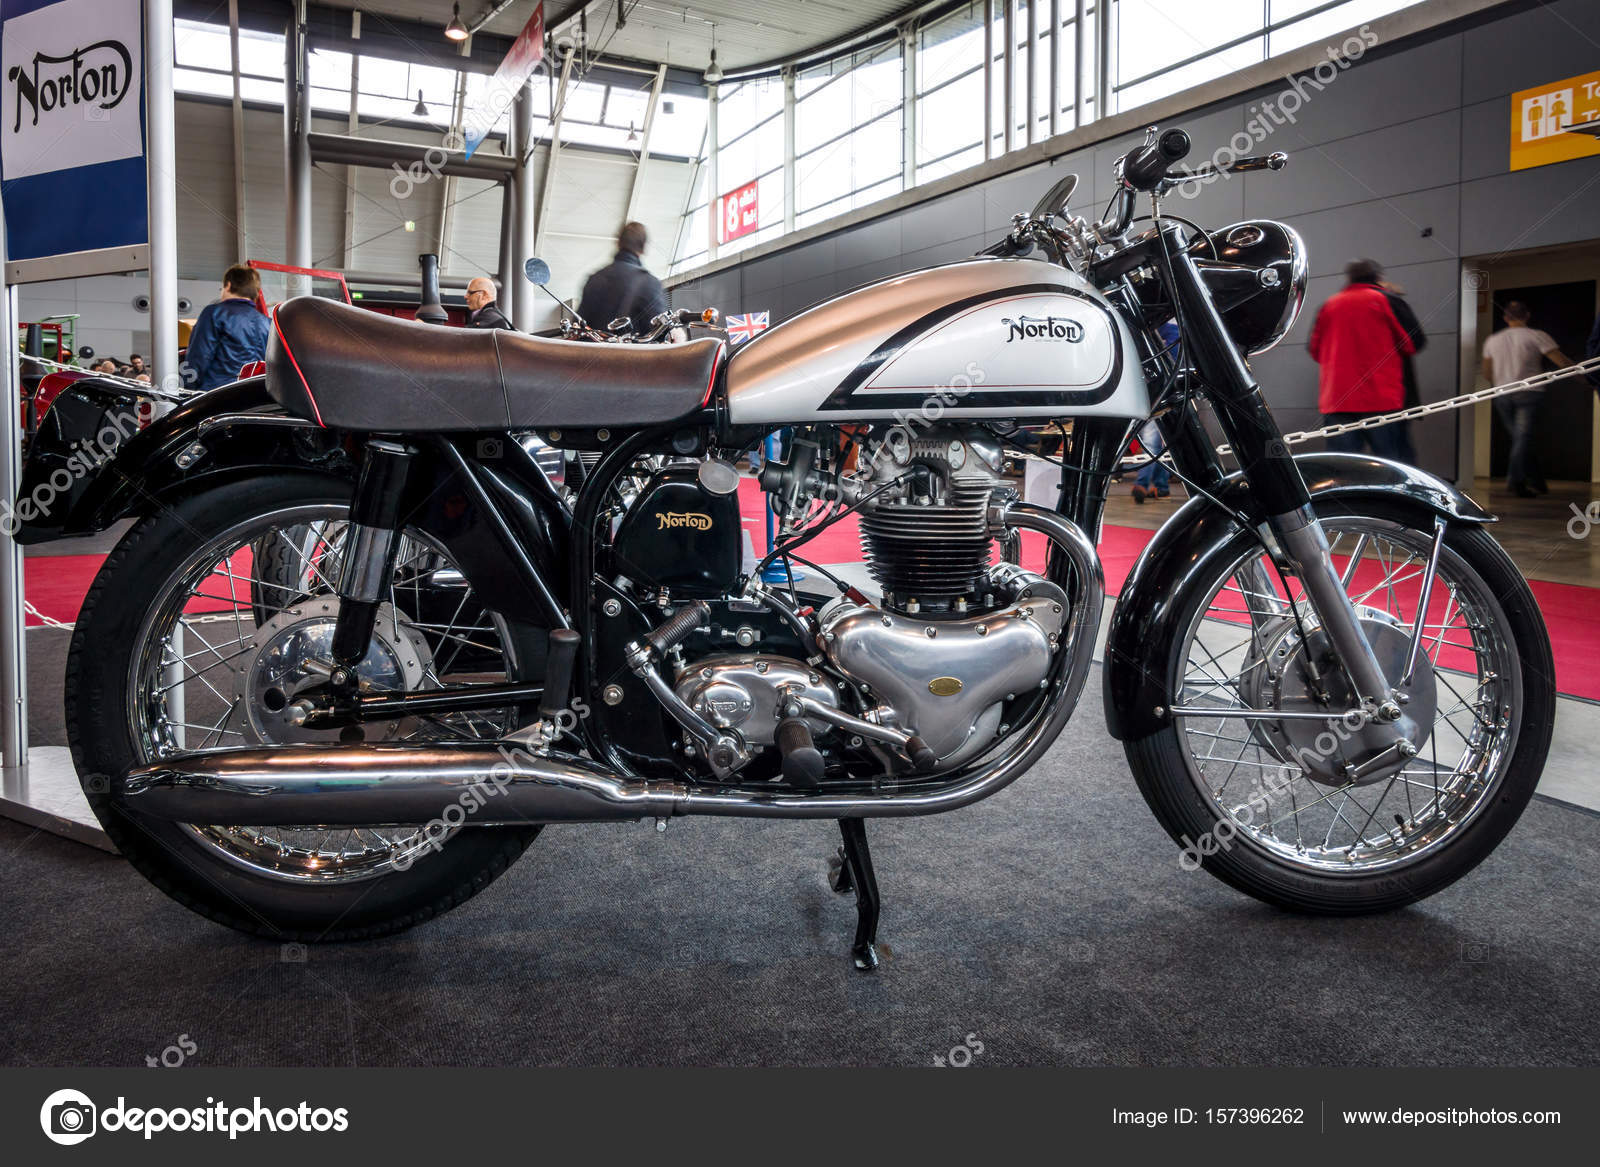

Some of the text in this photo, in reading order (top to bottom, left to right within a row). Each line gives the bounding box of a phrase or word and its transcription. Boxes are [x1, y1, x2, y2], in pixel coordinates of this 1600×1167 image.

[8, 40, 132, 133] Norton
[1001, 315, 1085, 343] Norton
[655, 511, 713, 531] Norton
